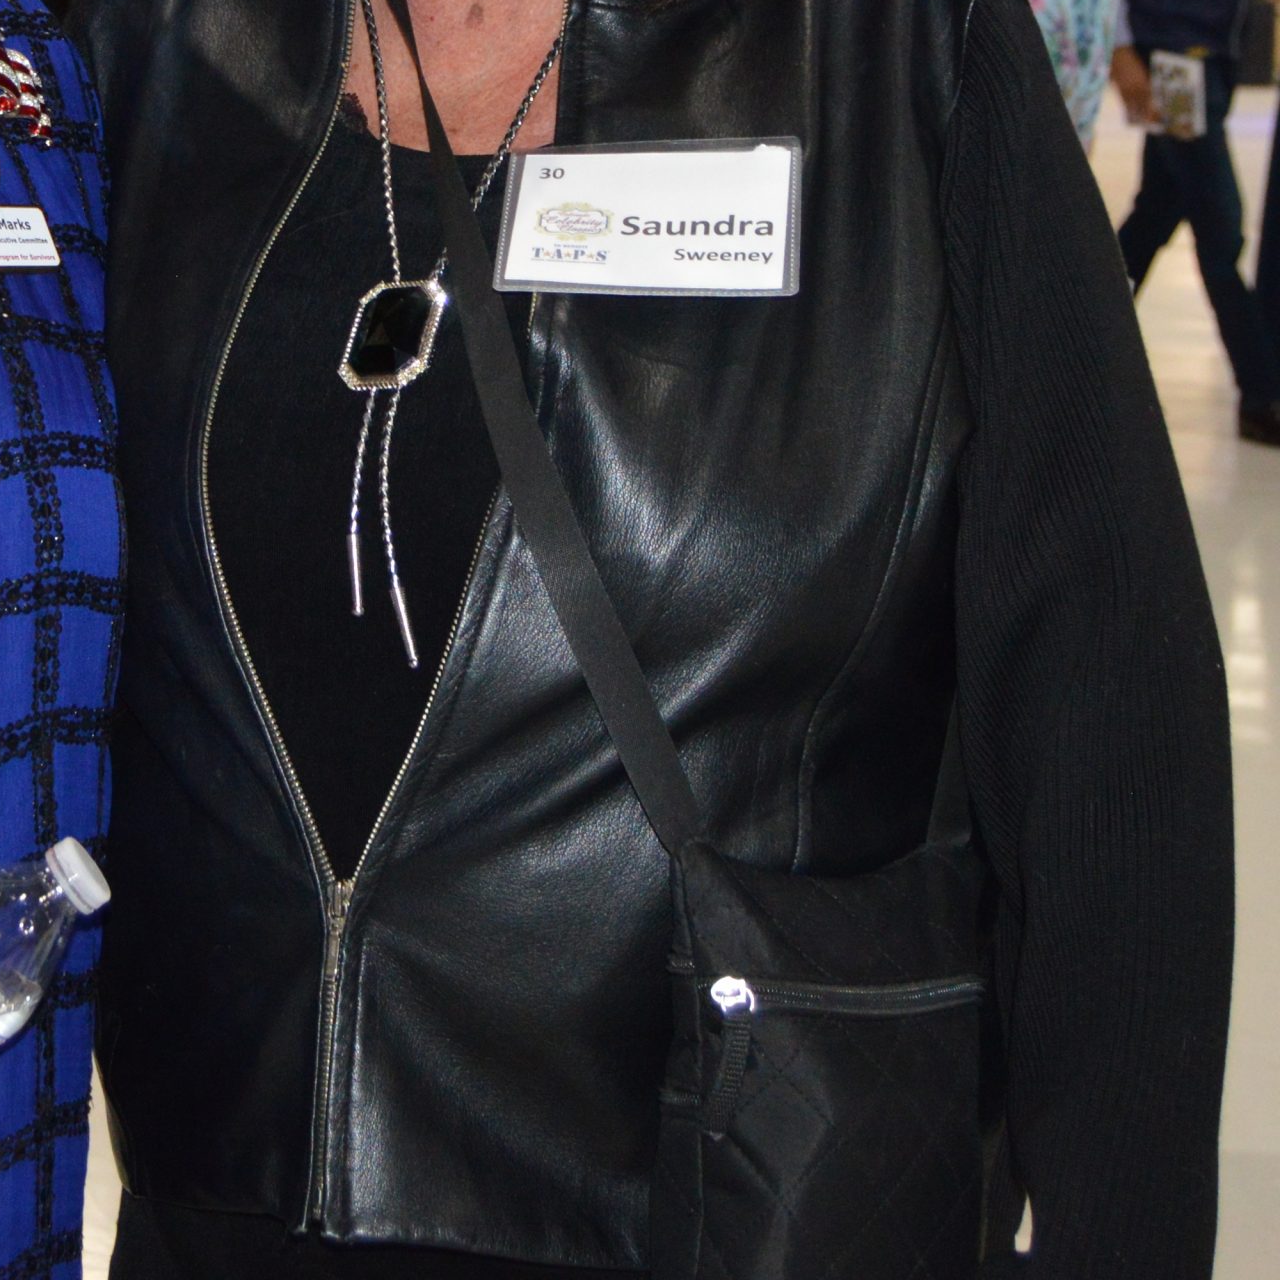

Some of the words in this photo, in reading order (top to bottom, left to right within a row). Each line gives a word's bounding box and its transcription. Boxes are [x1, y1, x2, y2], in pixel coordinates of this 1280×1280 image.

[539, 167, 565, 180] 30
[620, 214, 774, 236] Saundra
[673, 248, 774, 264] Sweeney
